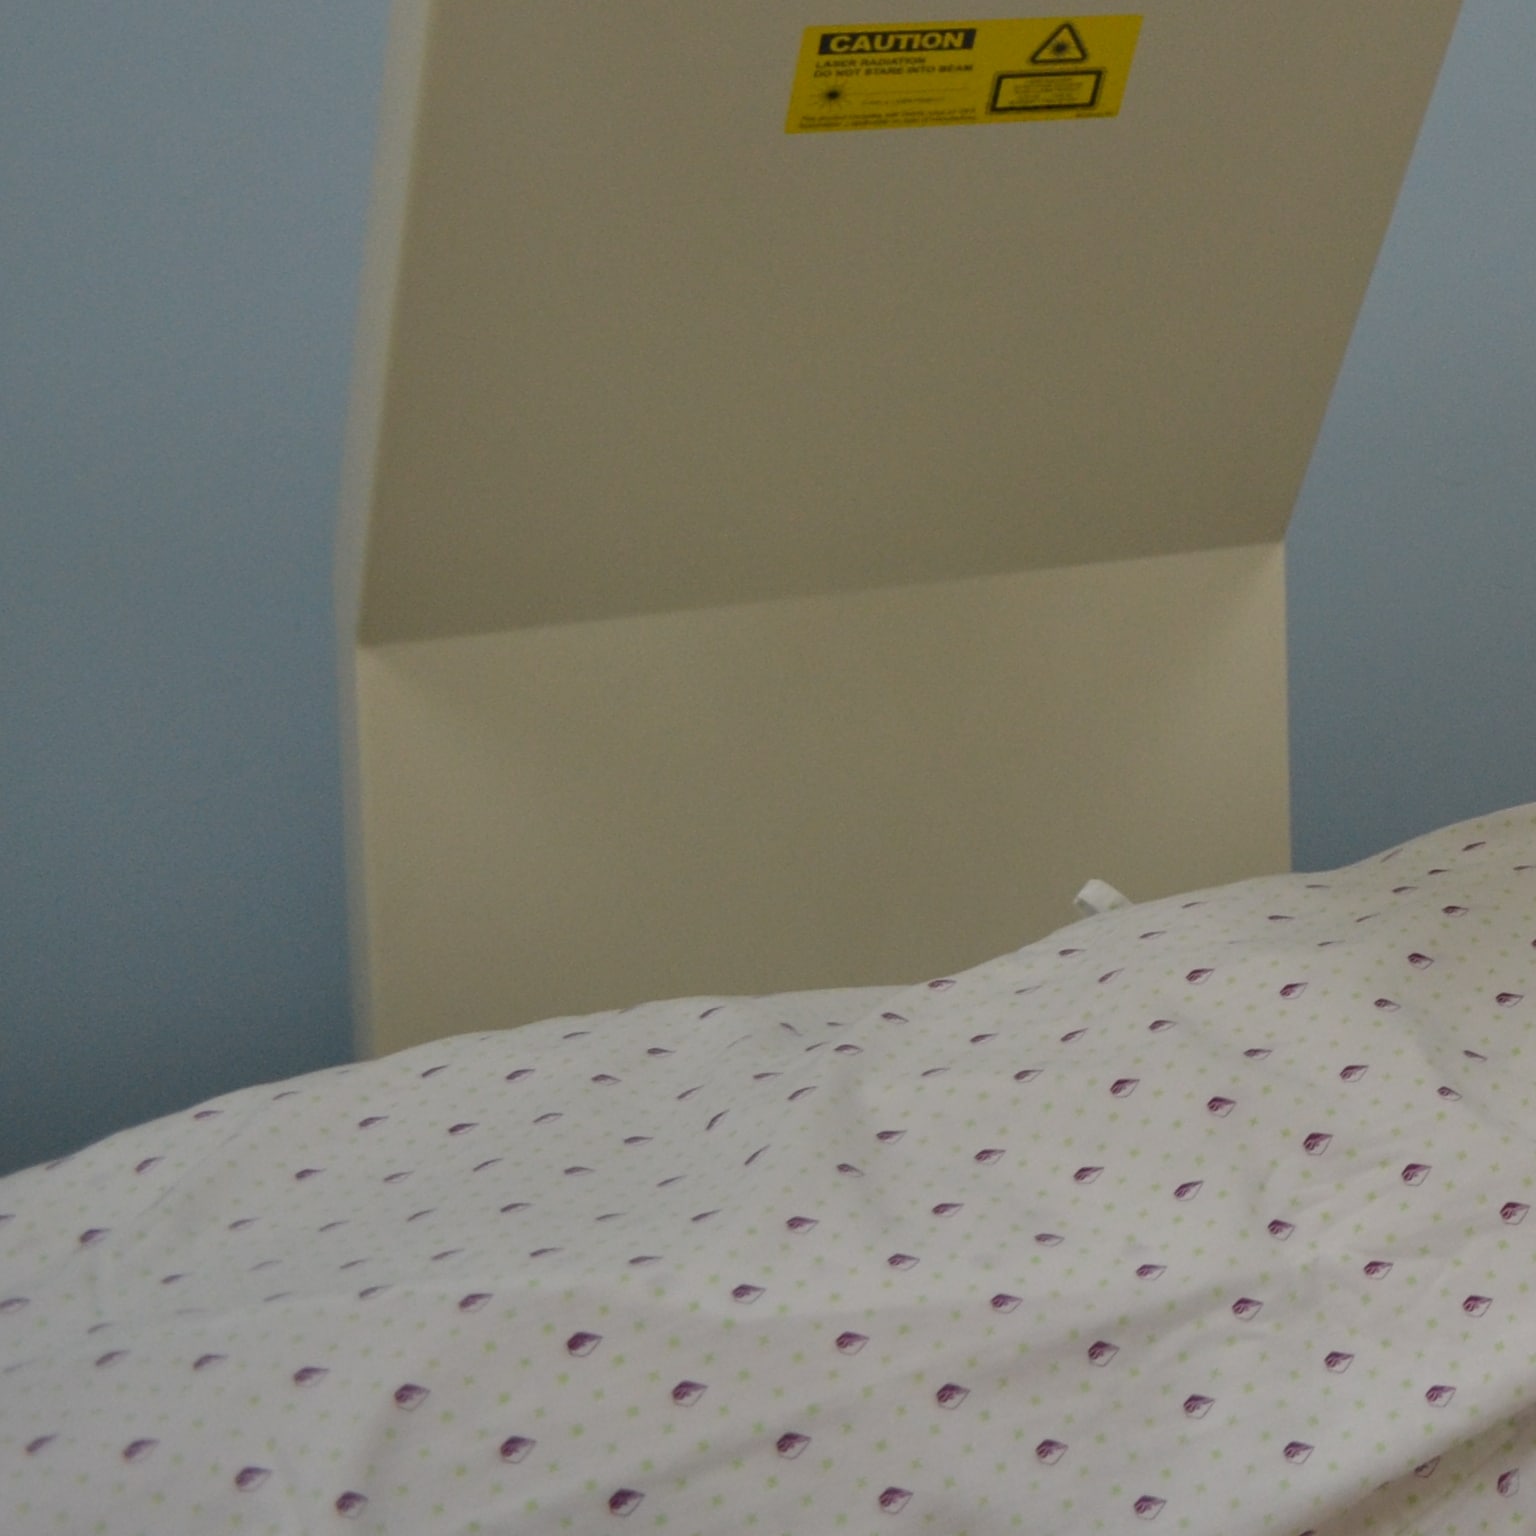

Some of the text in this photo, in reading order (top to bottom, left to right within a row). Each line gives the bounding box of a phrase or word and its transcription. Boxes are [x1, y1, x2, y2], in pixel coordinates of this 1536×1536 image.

[829, 31, 964, 52] CAUTION
[814, 63, 973, 78] DO NOT STARE INTO BEAM
[815, 58, 926, 69] LASER RADIATION
